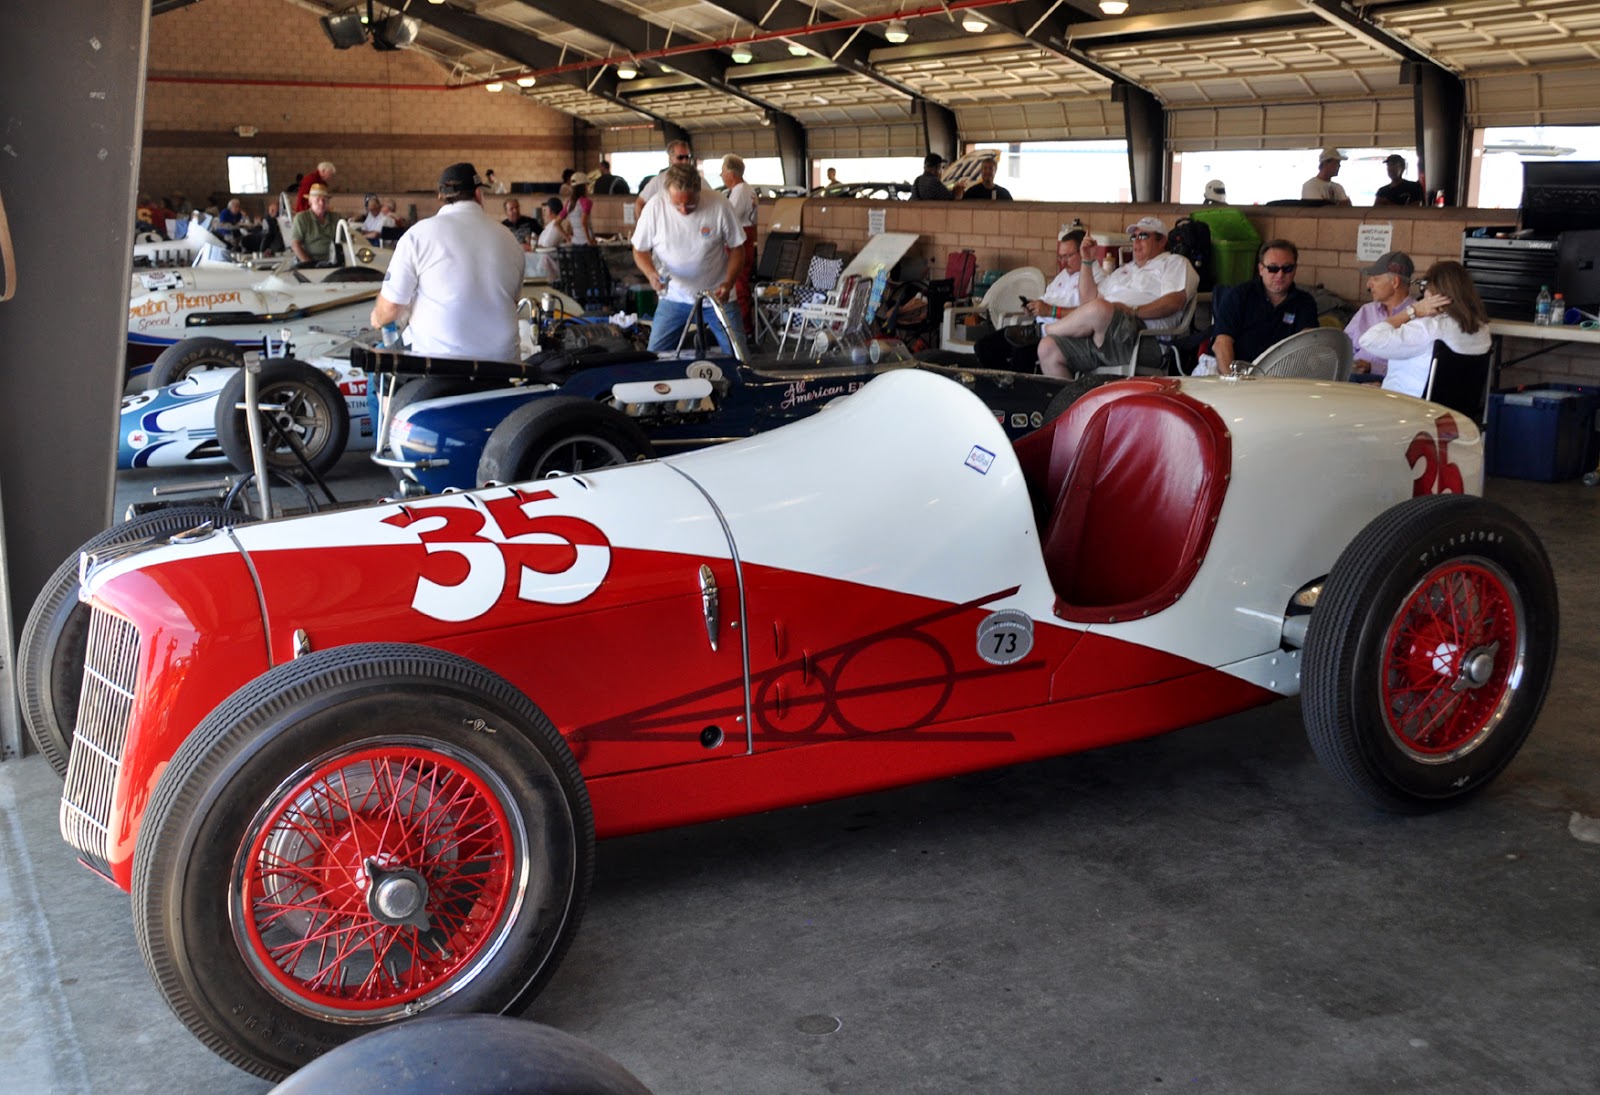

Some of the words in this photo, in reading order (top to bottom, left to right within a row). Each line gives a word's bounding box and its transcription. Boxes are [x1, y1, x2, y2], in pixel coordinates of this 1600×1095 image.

[169, 291, 243, 313] Thompson
[138, 316, 171, 331] Special
[699, 367, 713, 379] 69
[780, 385, 845, 409] American
[784, 380, 806, 397] All
[379, 489, 612, 623] 35
[994, 632, 1017, 654] 73
